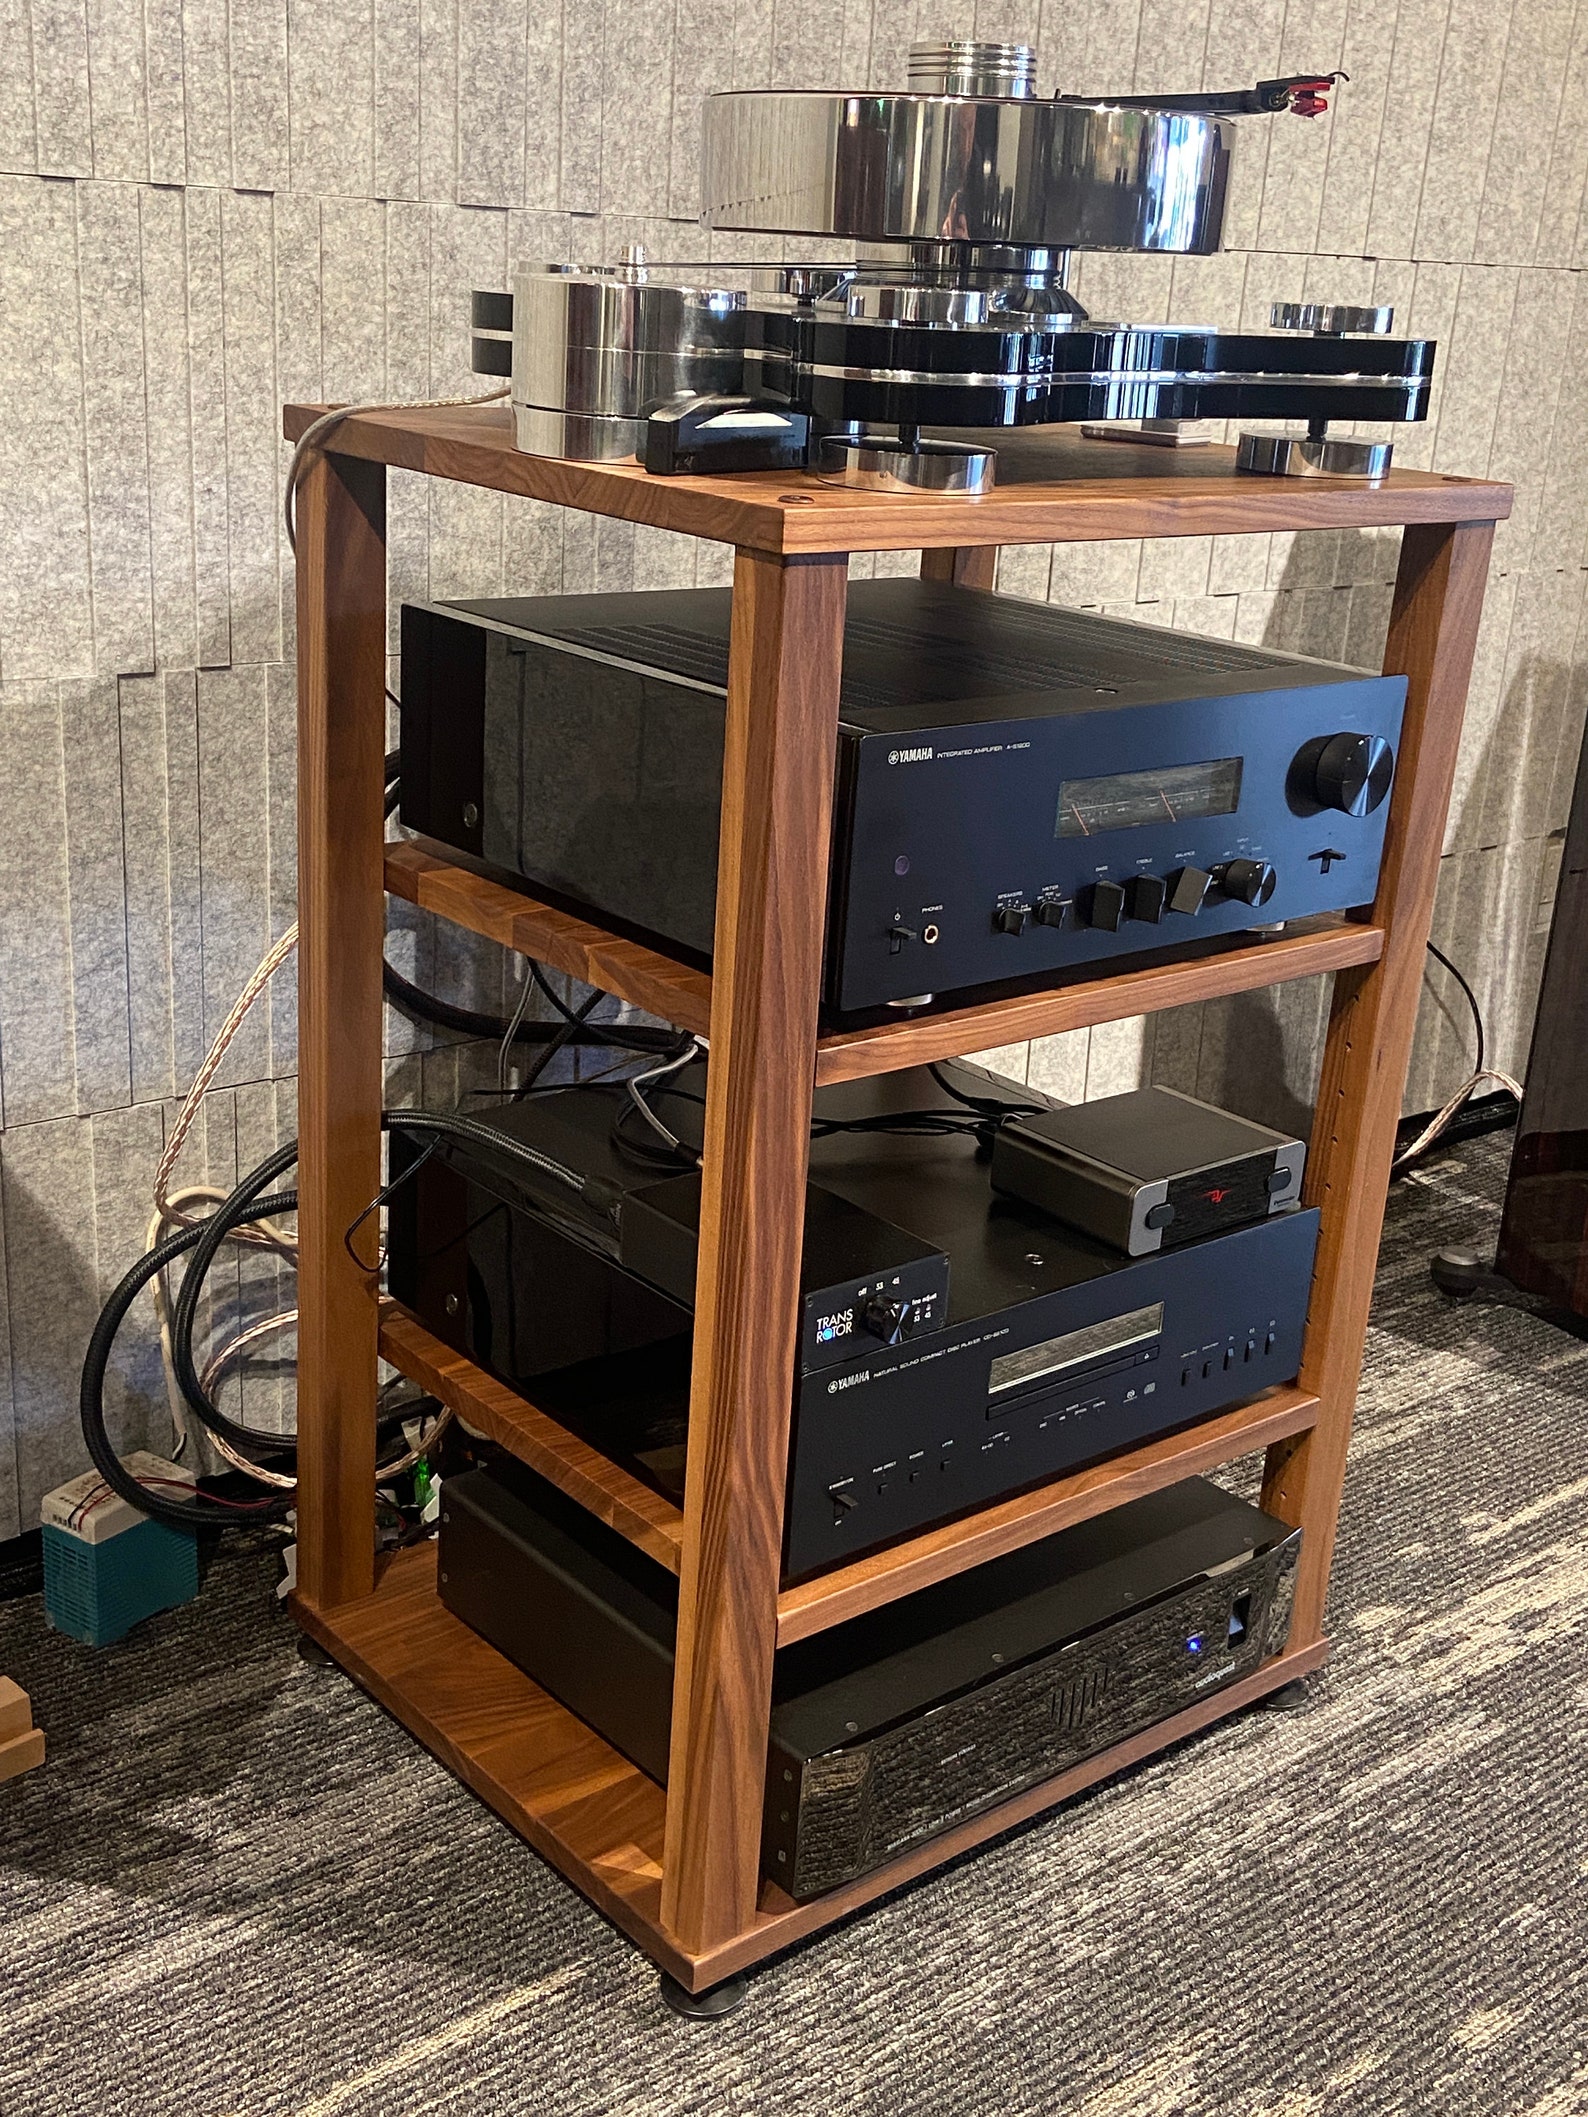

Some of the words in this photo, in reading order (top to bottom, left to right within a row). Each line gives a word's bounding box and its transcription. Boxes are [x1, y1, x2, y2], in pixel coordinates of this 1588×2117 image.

[899, 747, 933, 763] YAMAHA
[937, 750, 973, 759] INTEGRATED
[973, 745, 1003, 755] AMPLIFIER
[921, 905, 943, 913] PHONES
[816, 1308, 854, 1331] TRANS
[816, 1321, 853, 1344] ROTOR
[838, 1370, 870, 1391] YAMAHA
[873, 1366, 898, 1378] NATURAL
[899, 1357, 920, 1369] SOUND
[920, 1349, 947, 1362] COMPACT
[960, 1337, 981, 1348] PLAYER
[1195, 1660, 1236, 1689] audioquest
